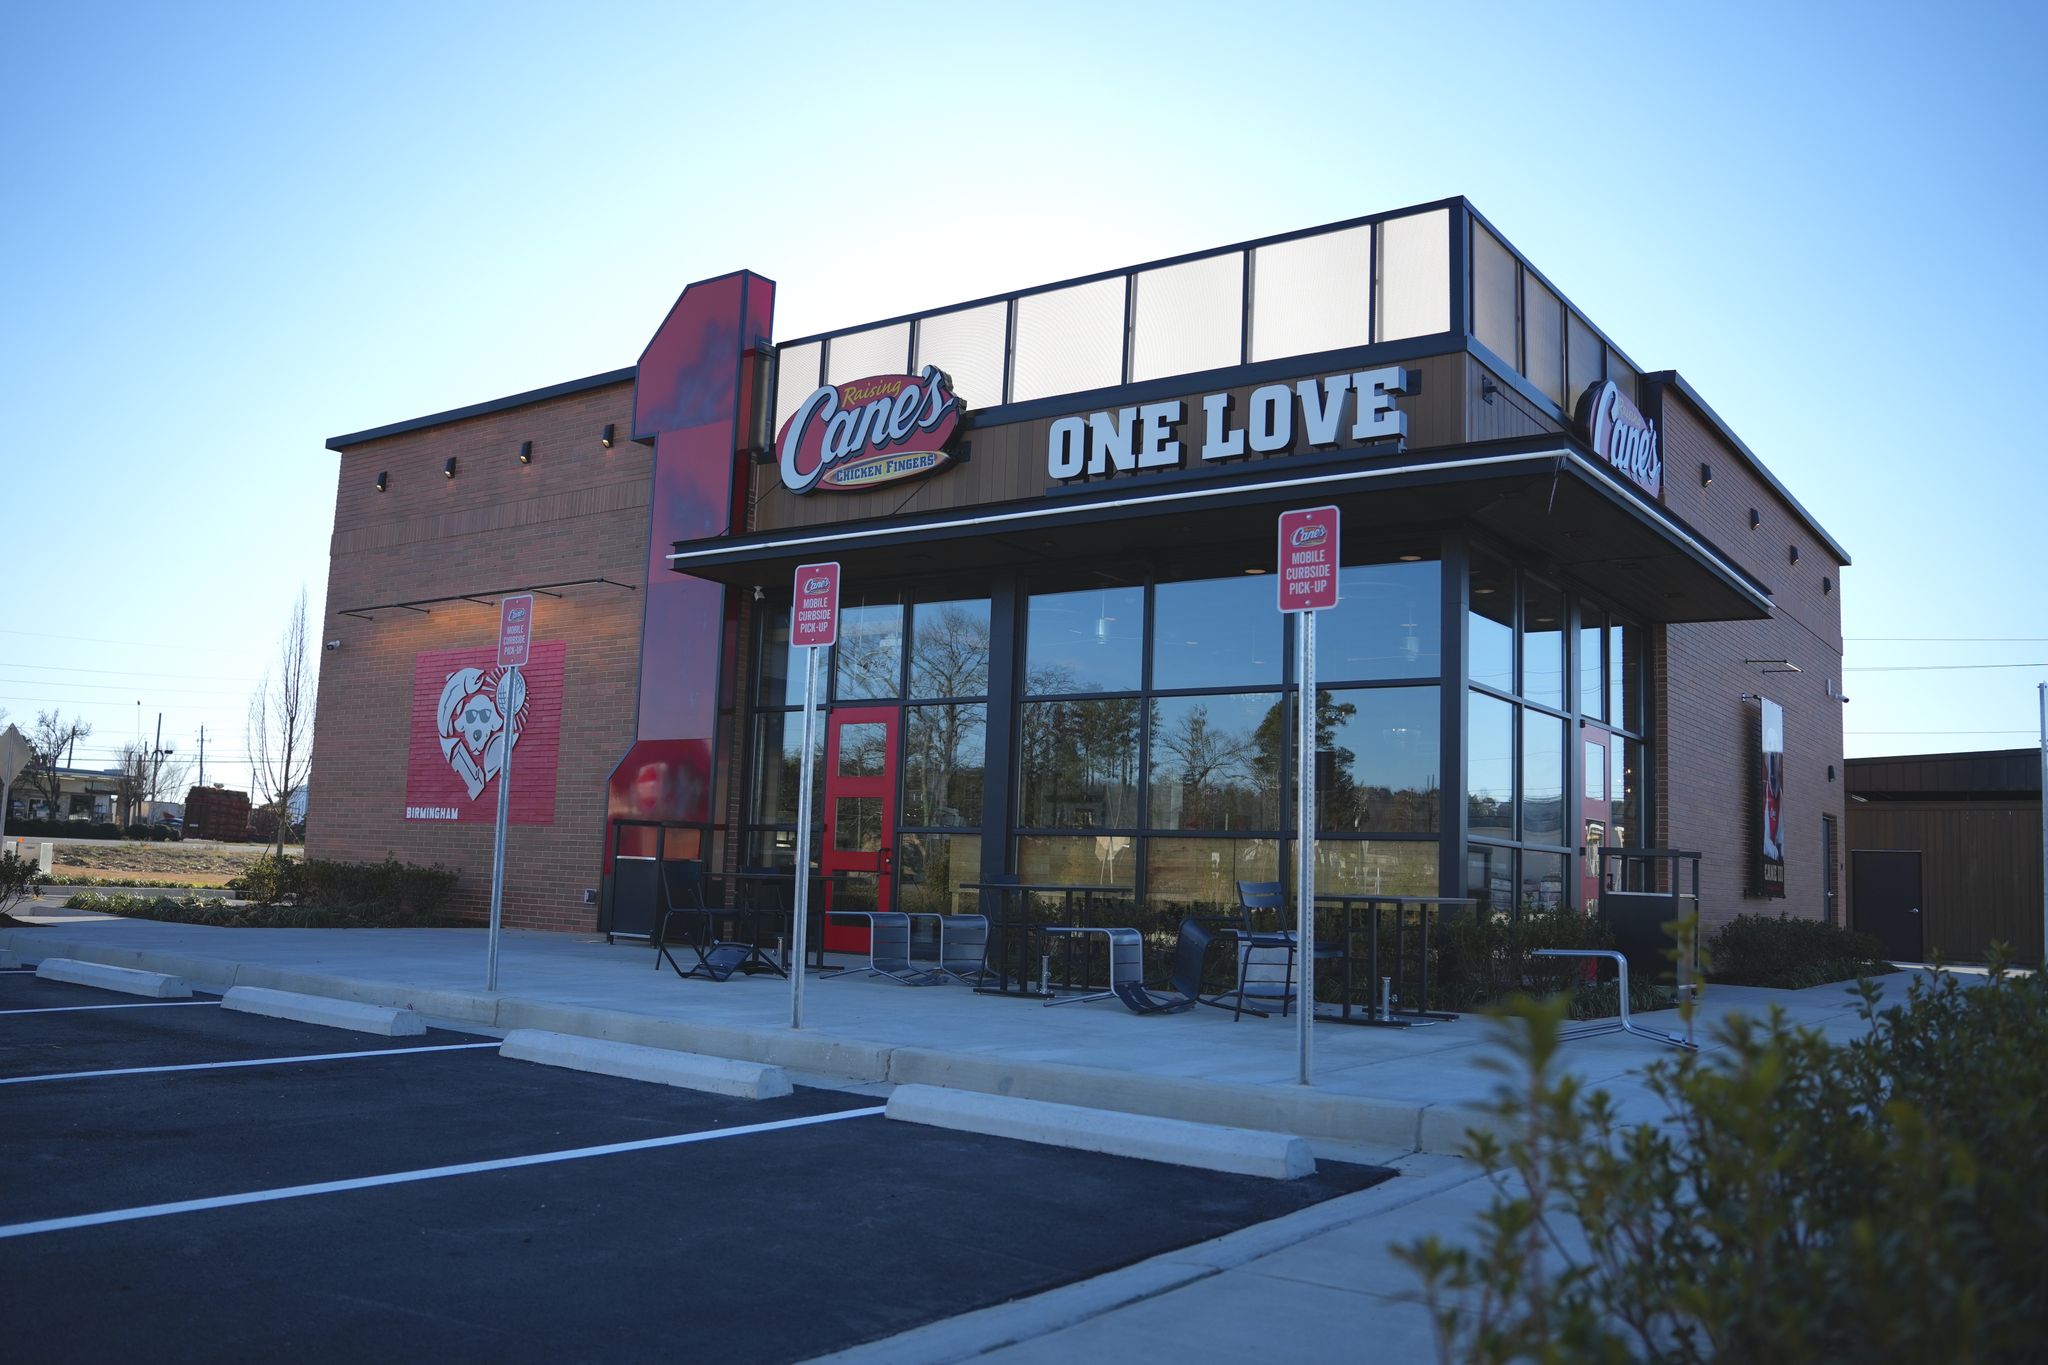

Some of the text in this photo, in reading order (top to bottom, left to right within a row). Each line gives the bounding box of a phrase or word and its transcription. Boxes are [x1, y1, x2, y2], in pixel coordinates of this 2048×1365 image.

[841, 379, 902, 408] Raising
[780, 365, 956, 491] Cane's
[1047, 366, 1405, 480] ONE LOVE
[835, 454, 935, 483] CHICKEN FINGERS
[1291, 549, 1326, 565] MOBILE
[1286, 564, 1331, 580] CURBSIDE
[1289, 579, 1328, 595] PICK-UP
[803, 597, 828, 609] MOBILE
[798, 609, 832, 622] CURBSIDE
[800, 621, 829, 634] PICK-UP
[406, 806, 459, 820] BIRMINGHAM
